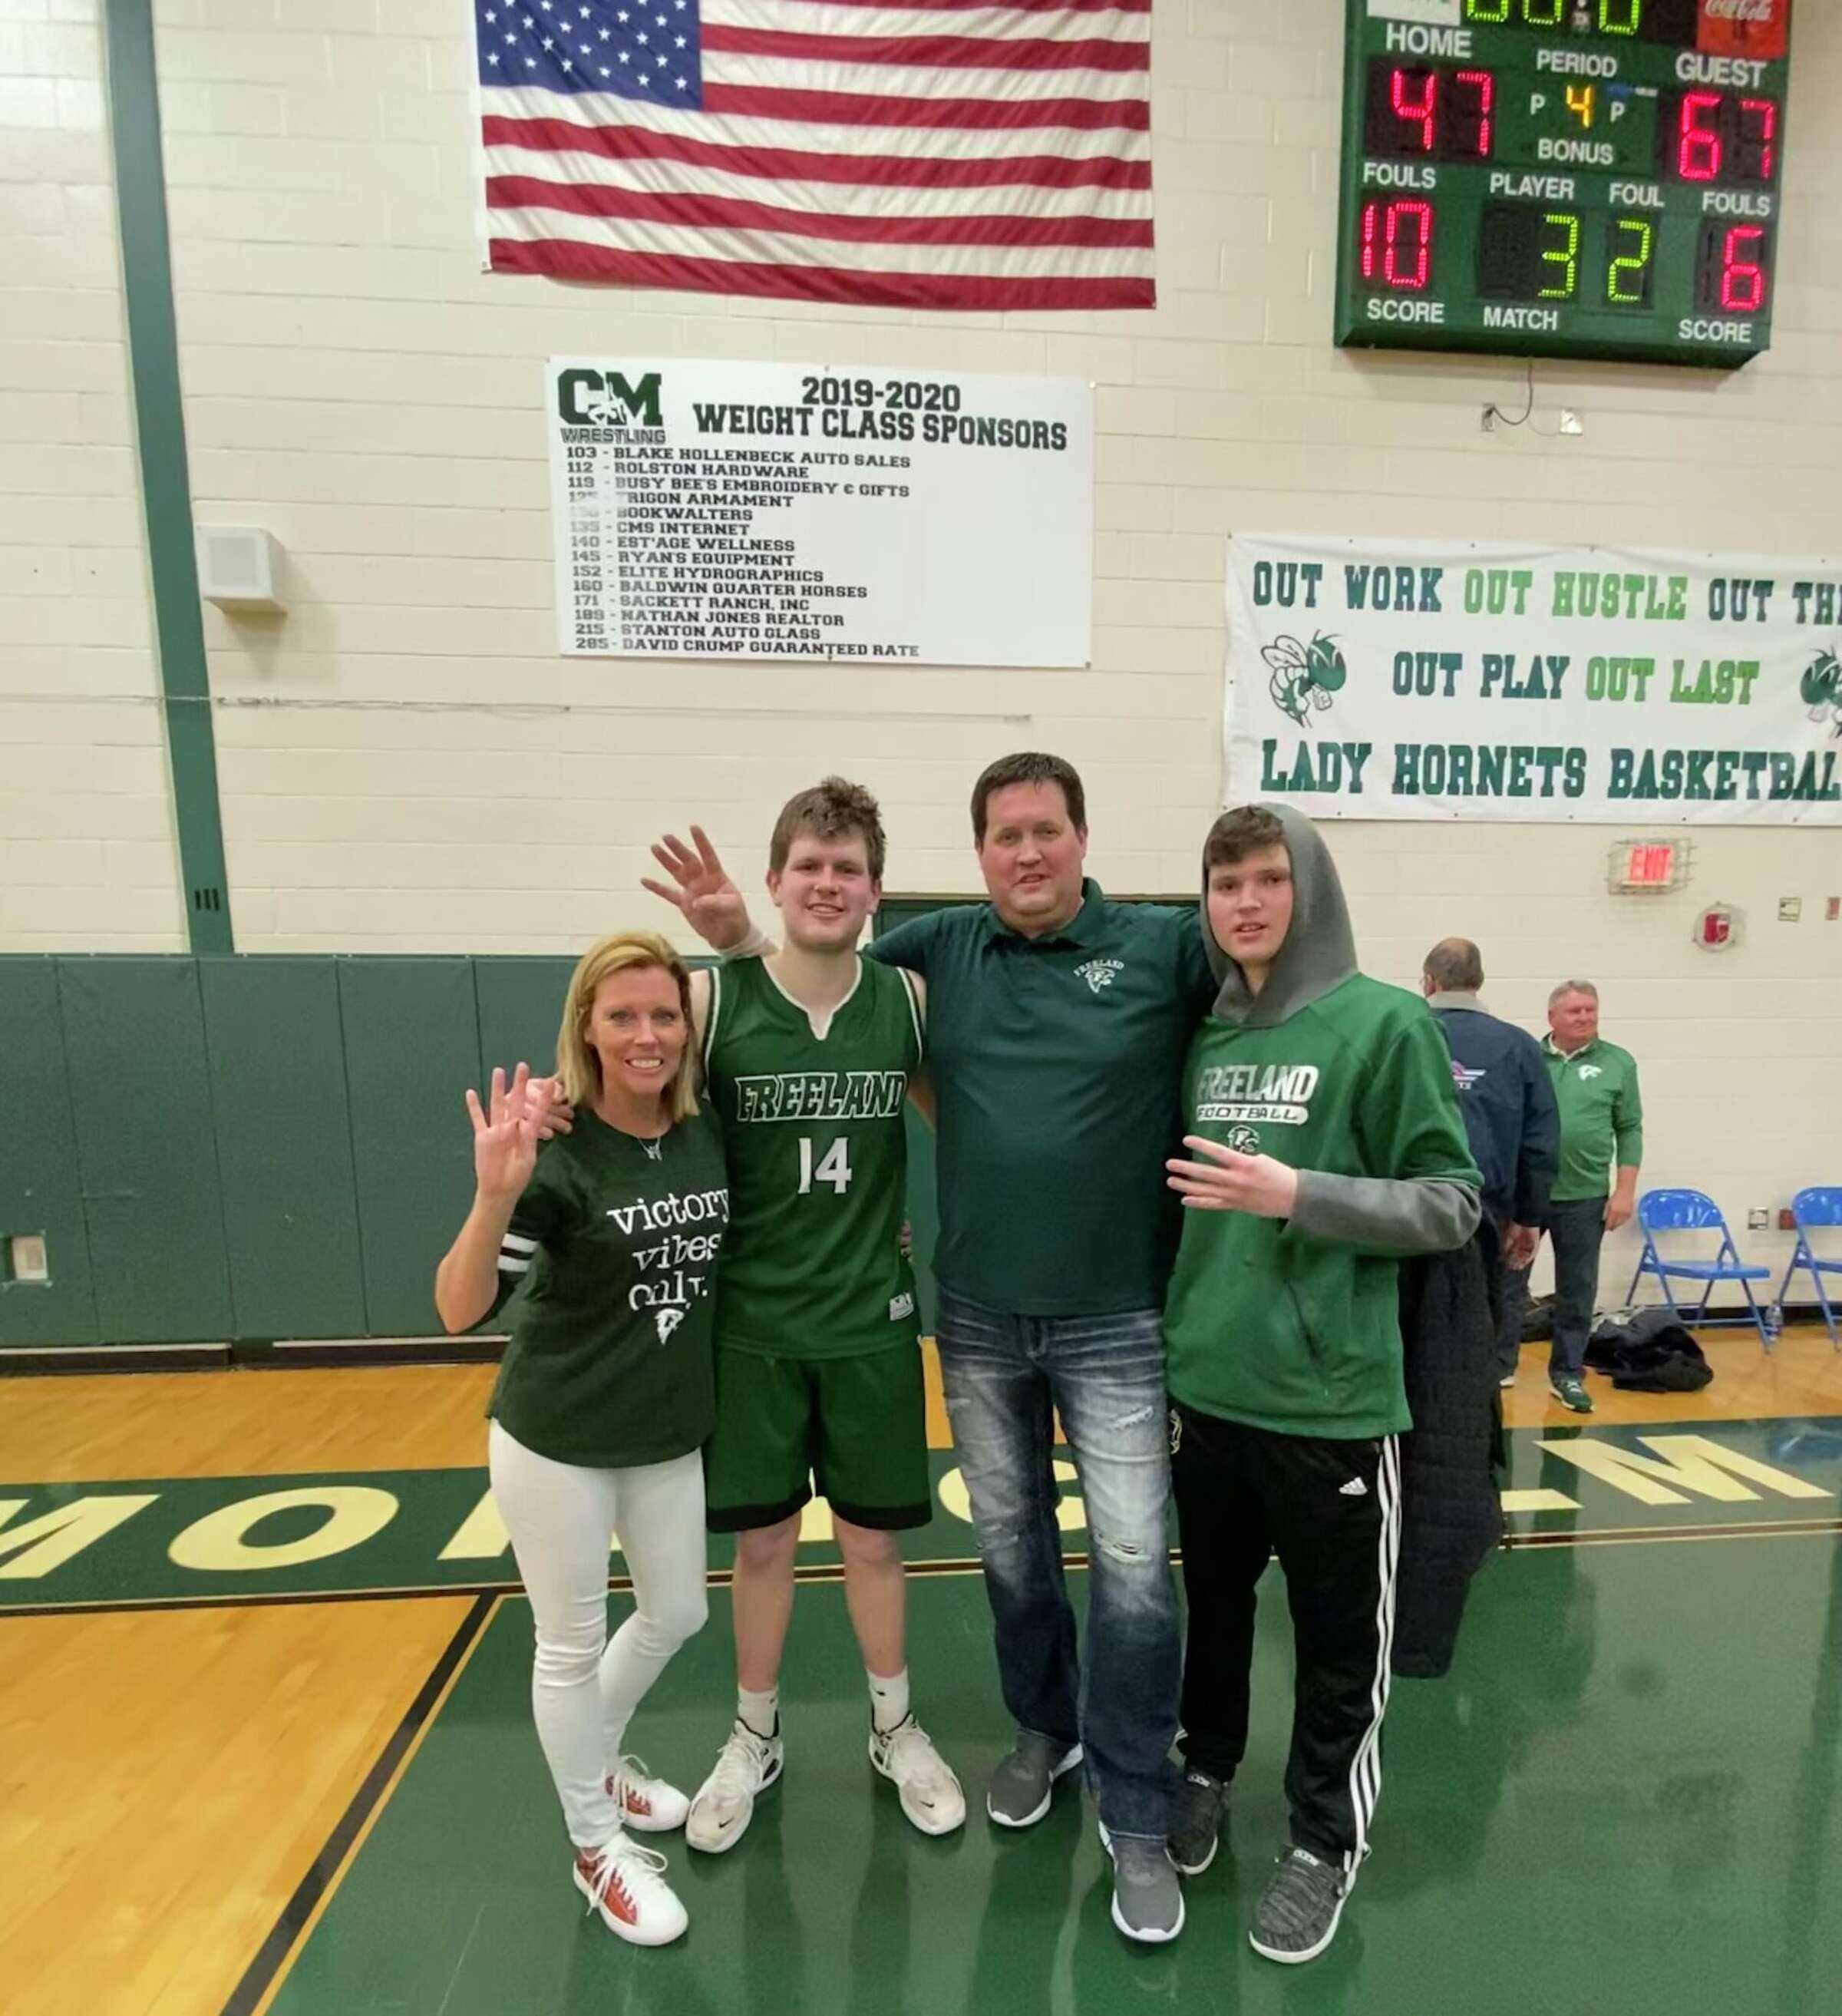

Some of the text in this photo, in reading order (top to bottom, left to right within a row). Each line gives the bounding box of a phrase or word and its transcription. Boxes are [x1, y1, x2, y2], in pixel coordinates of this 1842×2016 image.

[1386, 22, 1473, 58] HOME
[1537, 49, 1618, 78] PERIOD
[1675, 53, 1768, 89] GUEST
[1391, 69, 1493, 157] 47
[1530, 94, 1545, 114] P
[1566, 84, 1593, 129] 4
[1610, 101, 1625, 122] P
[1679, 91, 1775, 181] 67
[1538, 138, 1614, 166] BONUS
[1363, 162, 1437, 190] FOULS
[1490, 173, 1575, 200] PLAYER
[1609, 183, 1665, 207] FOUL
[1702, 191, 1771, 216] FOULS
[1362, 202, 1431, 289] 10
[1537, 214, 1579, 298] 3
[1608, 220, 1651, 303] 2
[1721, 225, 1763, 311] 6
[1367, 298, 1444, 325] SCORE
[1483, 306, 1558, 332] MATCH
[1679, 319, 1752, 343] SCORE
[557, 368, 664, 427] CM
[802, 377, 961, 412] 2019-2020
[560, 427, 666, 445] WRESTLING
[692, 403, 1068, 451] WEIGHT CLASS SPONSORS
[567, 447, 596, 458] 103
[614, 448, 674, 459] BLAKE
[679, 448, 795, 463] HOLLENBECK
[801, 452, 849, 465] AUTO
[854, 454, 911, 468] SALES
[567, 462, 593, 474] 112
[615, 462, 697, 475] ROLSTON
[702, 464, 810, 478] HARDWARE
[616, 477, 665, 489] BUSY
[671, 478, 718, 490] BEE'S
[722, 479, 839, 494] EMBROIDERY
[859, 484, 909, 497] GIFTS
[616, 491, 682, 504] TRIGON
[686, 493, 795, 507] ARMAMENT
[617, 507, 754, 521] BOOKWALTERS
[617, 522, 655, 533] CMS
[660, 524, 751, 536] INTERNET
[572, 536, 600, 547] 140
[617, 537, 691, 549] EST'AGE
[696, 539, 795, 552] WELLNESS
[572, 550, 601, 562] 145
[619, 551, 687, 563] RYAN'S
[692, 553, 795, 567] EQUIPMENT
[573, 566, 602, 577] 152
[619, 566, 668, 577] ELITE
[674, 567, 824, 583] HYDROGRAPHICS
[573, 580, 602, 592] 160
[620, 581, 708, 593] BALDWIN
[713, 583, 796, 596] QUARTER
[801, 585, 868, 598] HORSES
[1253, 561, 1322, 608] OUT
[1344, 564, 1444, 613] WORK
[1464, 569, 1533, 615] OUT
[1552, 571, 1688, 621] HUSTLE
[1708, 578, 1774, 622] OUT
[575, 595, 599, 606] 171
[620, 596, 704, 608] SACKETT
[709, 597, 775, 611] RANCH,
[781, 599, 810, 611] INC
[576, 623, 605, 635] 215
[622, 624, 706, 636] STANTON
[712, 626, 760, 638] AUTO
[764, 627, 821, 640] GLASS
[621, 610, 700, 623] NATHAN
[705, 612, 761, 624] JONES
[766, 613, 845, 626] REALTOR
[576, 637, 609, 649] 285
[623, 639, 679, 651] DAVID
[683, 640, 745, 653] CRUMP
[750, 642, 868, 656] GUARANTEED
[873, 645, 920, 657] RATE
[1393, 651, 1760, 706] OUT PLAY OUT LAST
[1260, 739, 1372, 794] LADY
[1391, 743, 1587, 799] HORNETS
[734, 1071, 909, 1122] FREELAND
[1197, 1064, 1319, 1103] FREELAND
[1198, 1106, 1299, 1120] FOOTBALL
[797, 1137, 852, 1194] 14
